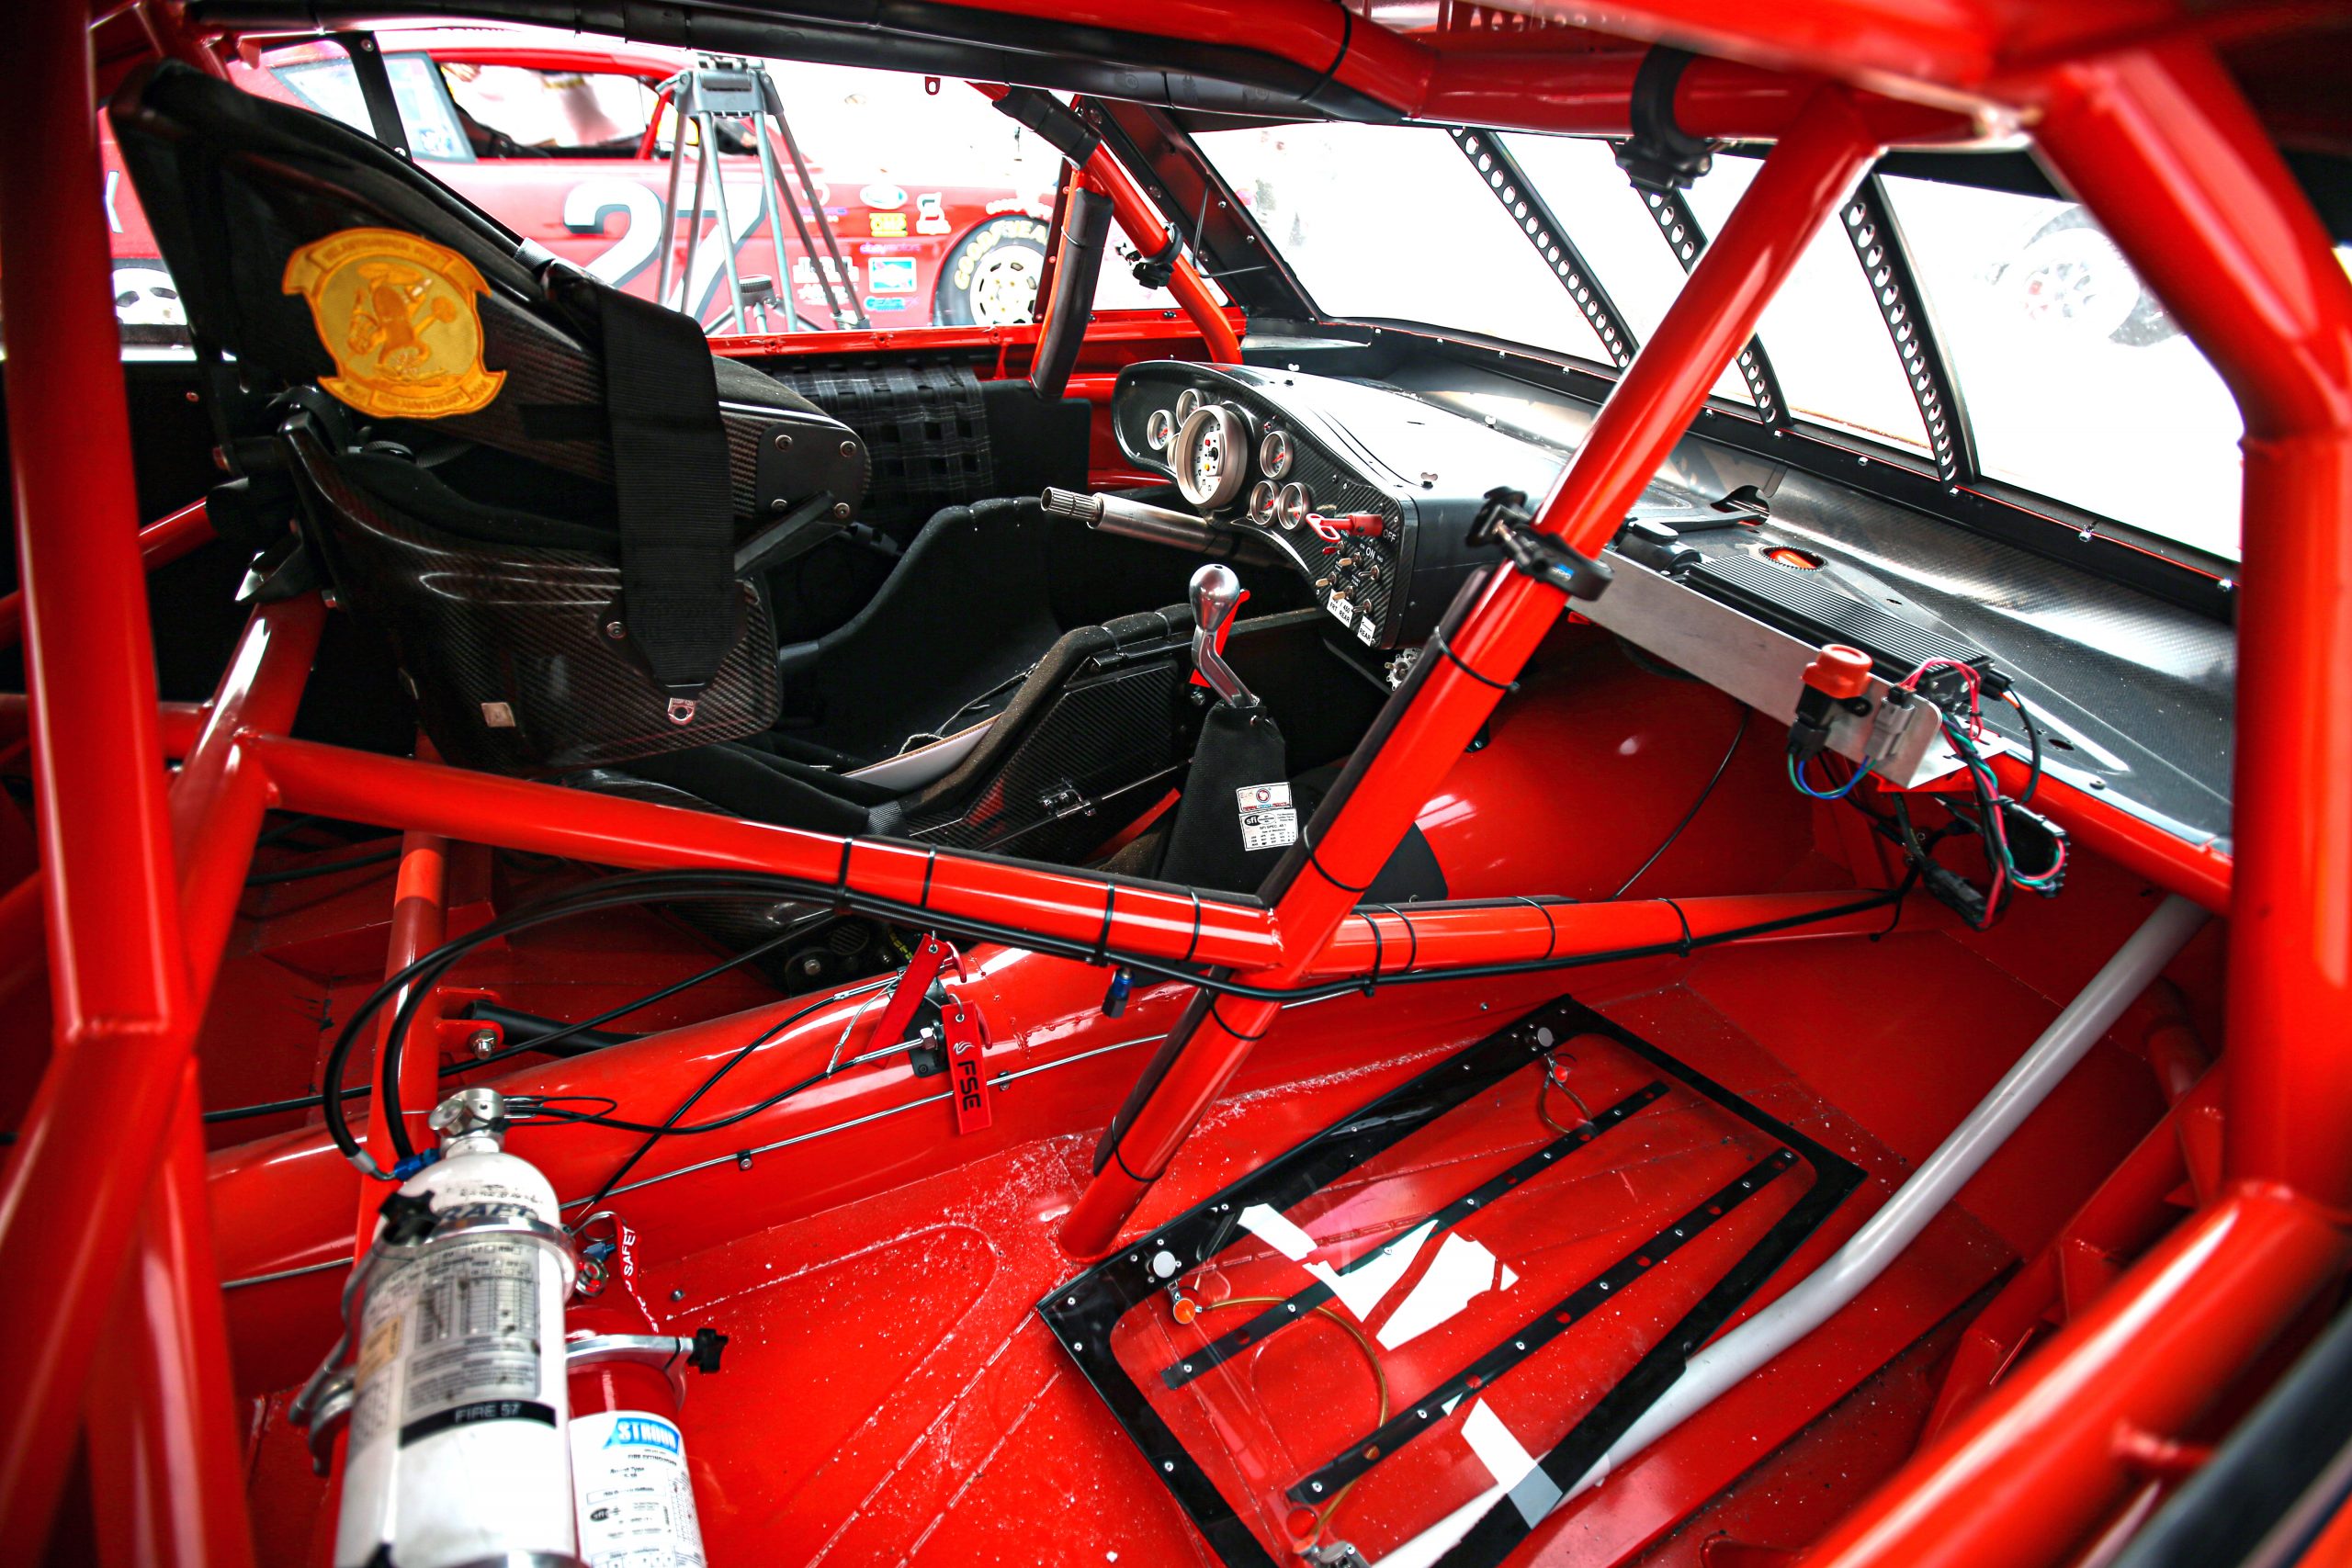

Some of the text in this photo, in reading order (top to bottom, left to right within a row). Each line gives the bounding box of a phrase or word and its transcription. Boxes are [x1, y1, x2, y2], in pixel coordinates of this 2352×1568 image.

[563, 181, 769, 319] 27
[955, 220, 1048, 290] GOODYEA
[1383, 529, 1397, 542] OFF
[1365, 547, 1376, 559] ON
[1329, 602, 1351, 623] FRT REAR
[1360, 627, 1372, 641] REAR
[1247, 816, 1258, 825] sfi
[957, 1059, 981, 1111] FSE
[621, 1224, 636, 1277] SAFET
[455, 1403, 522, 1423] FIRE 57
